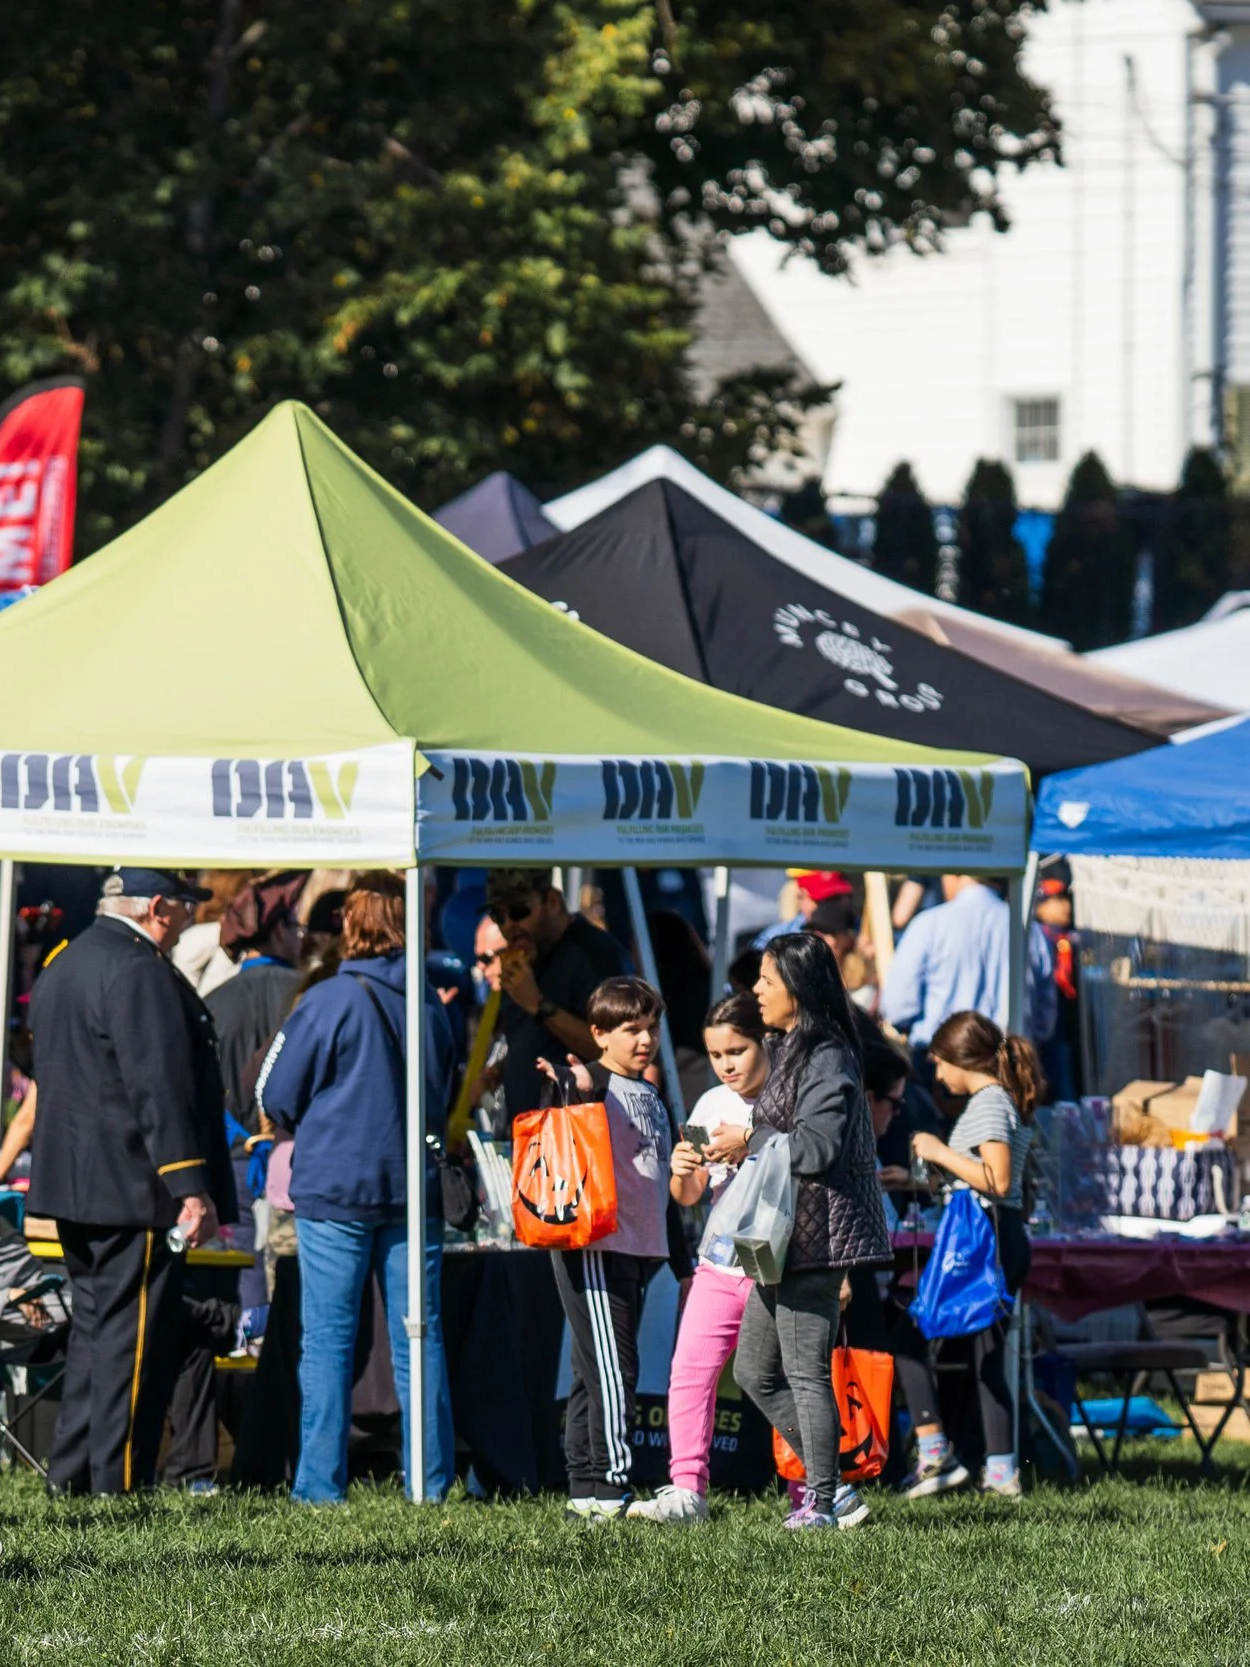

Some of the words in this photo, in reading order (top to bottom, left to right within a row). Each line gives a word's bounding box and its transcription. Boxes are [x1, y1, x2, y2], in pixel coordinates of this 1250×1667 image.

[843, 678, 944, 713] GROUP
[1, 754, 149, 814] DAV
[212, 758, 359, 820] DAV
[452, 758, 556, 821] DAV
[601, 759, 705, 820] DAV
[749, 760, 851, 823] DAV
[894, 768, 994, 829] DAV
